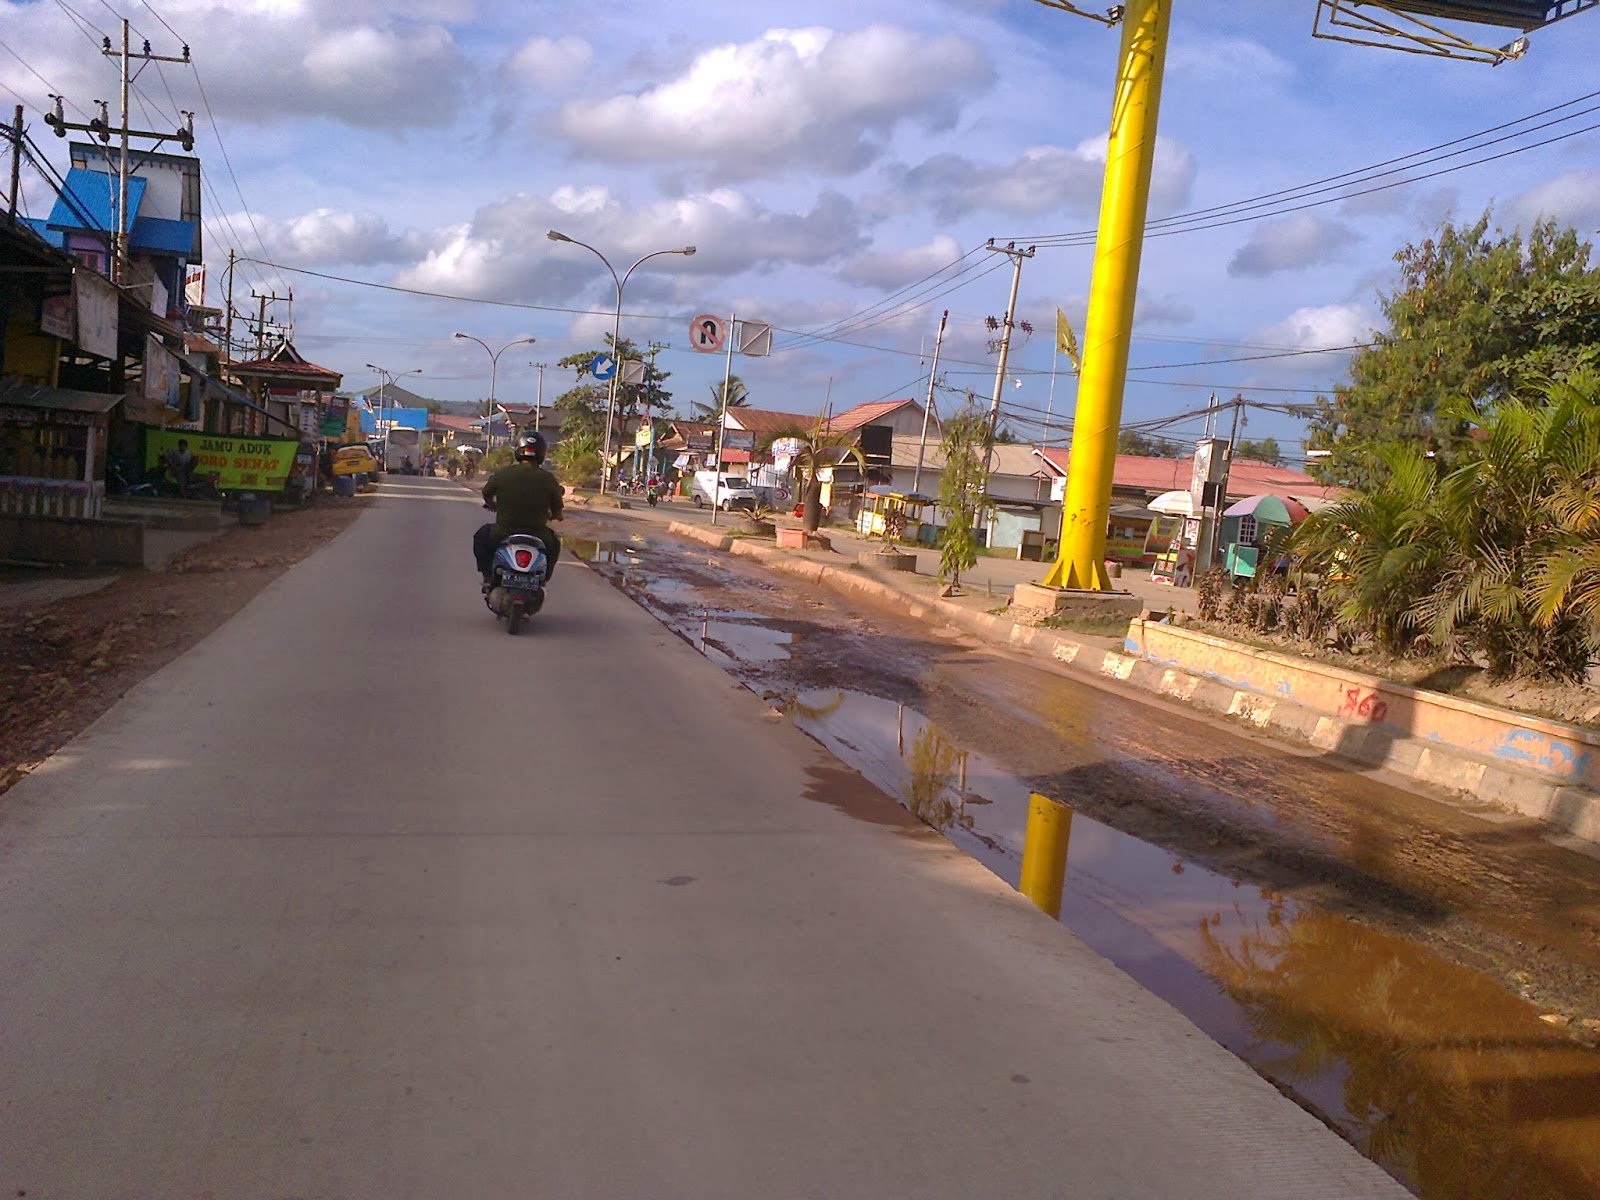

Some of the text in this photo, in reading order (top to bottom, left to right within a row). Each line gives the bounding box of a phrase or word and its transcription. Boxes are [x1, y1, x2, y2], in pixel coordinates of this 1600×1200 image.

[200, 439, 272, 455] JAMU ADUK
[193, 453, 280, 471] ORO SEHAT
